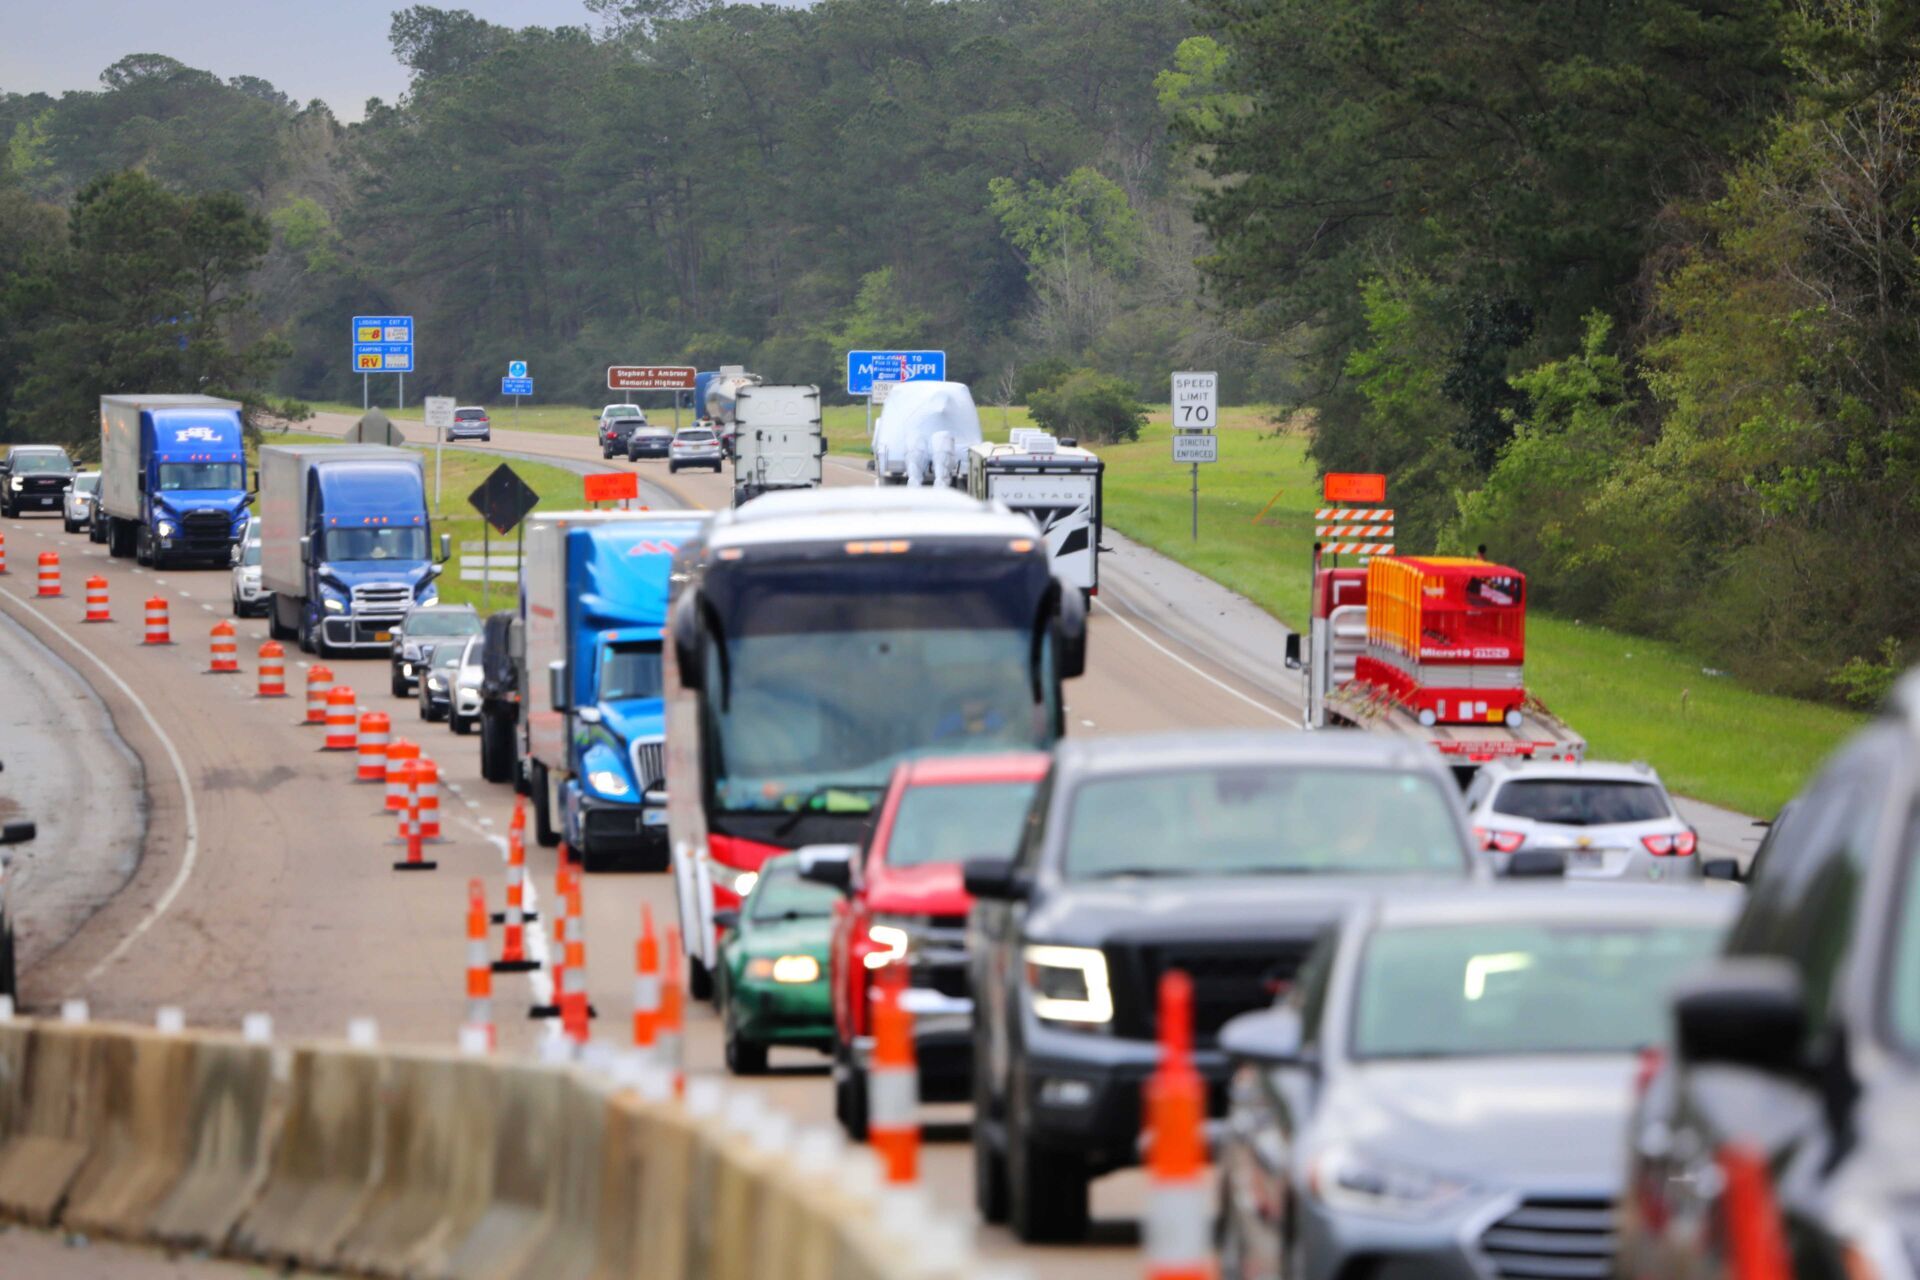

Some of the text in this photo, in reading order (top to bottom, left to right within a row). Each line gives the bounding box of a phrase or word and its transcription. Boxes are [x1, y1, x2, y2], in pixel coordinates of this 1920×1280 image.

[372, 329, 380, 339] 8
[361, 358, 378, 368] RV
[1176, 379, 1213, 388] SPEED
[1180, 392, 1209, 401] LIMIT
[1181, 406, 1209, 422] 70
